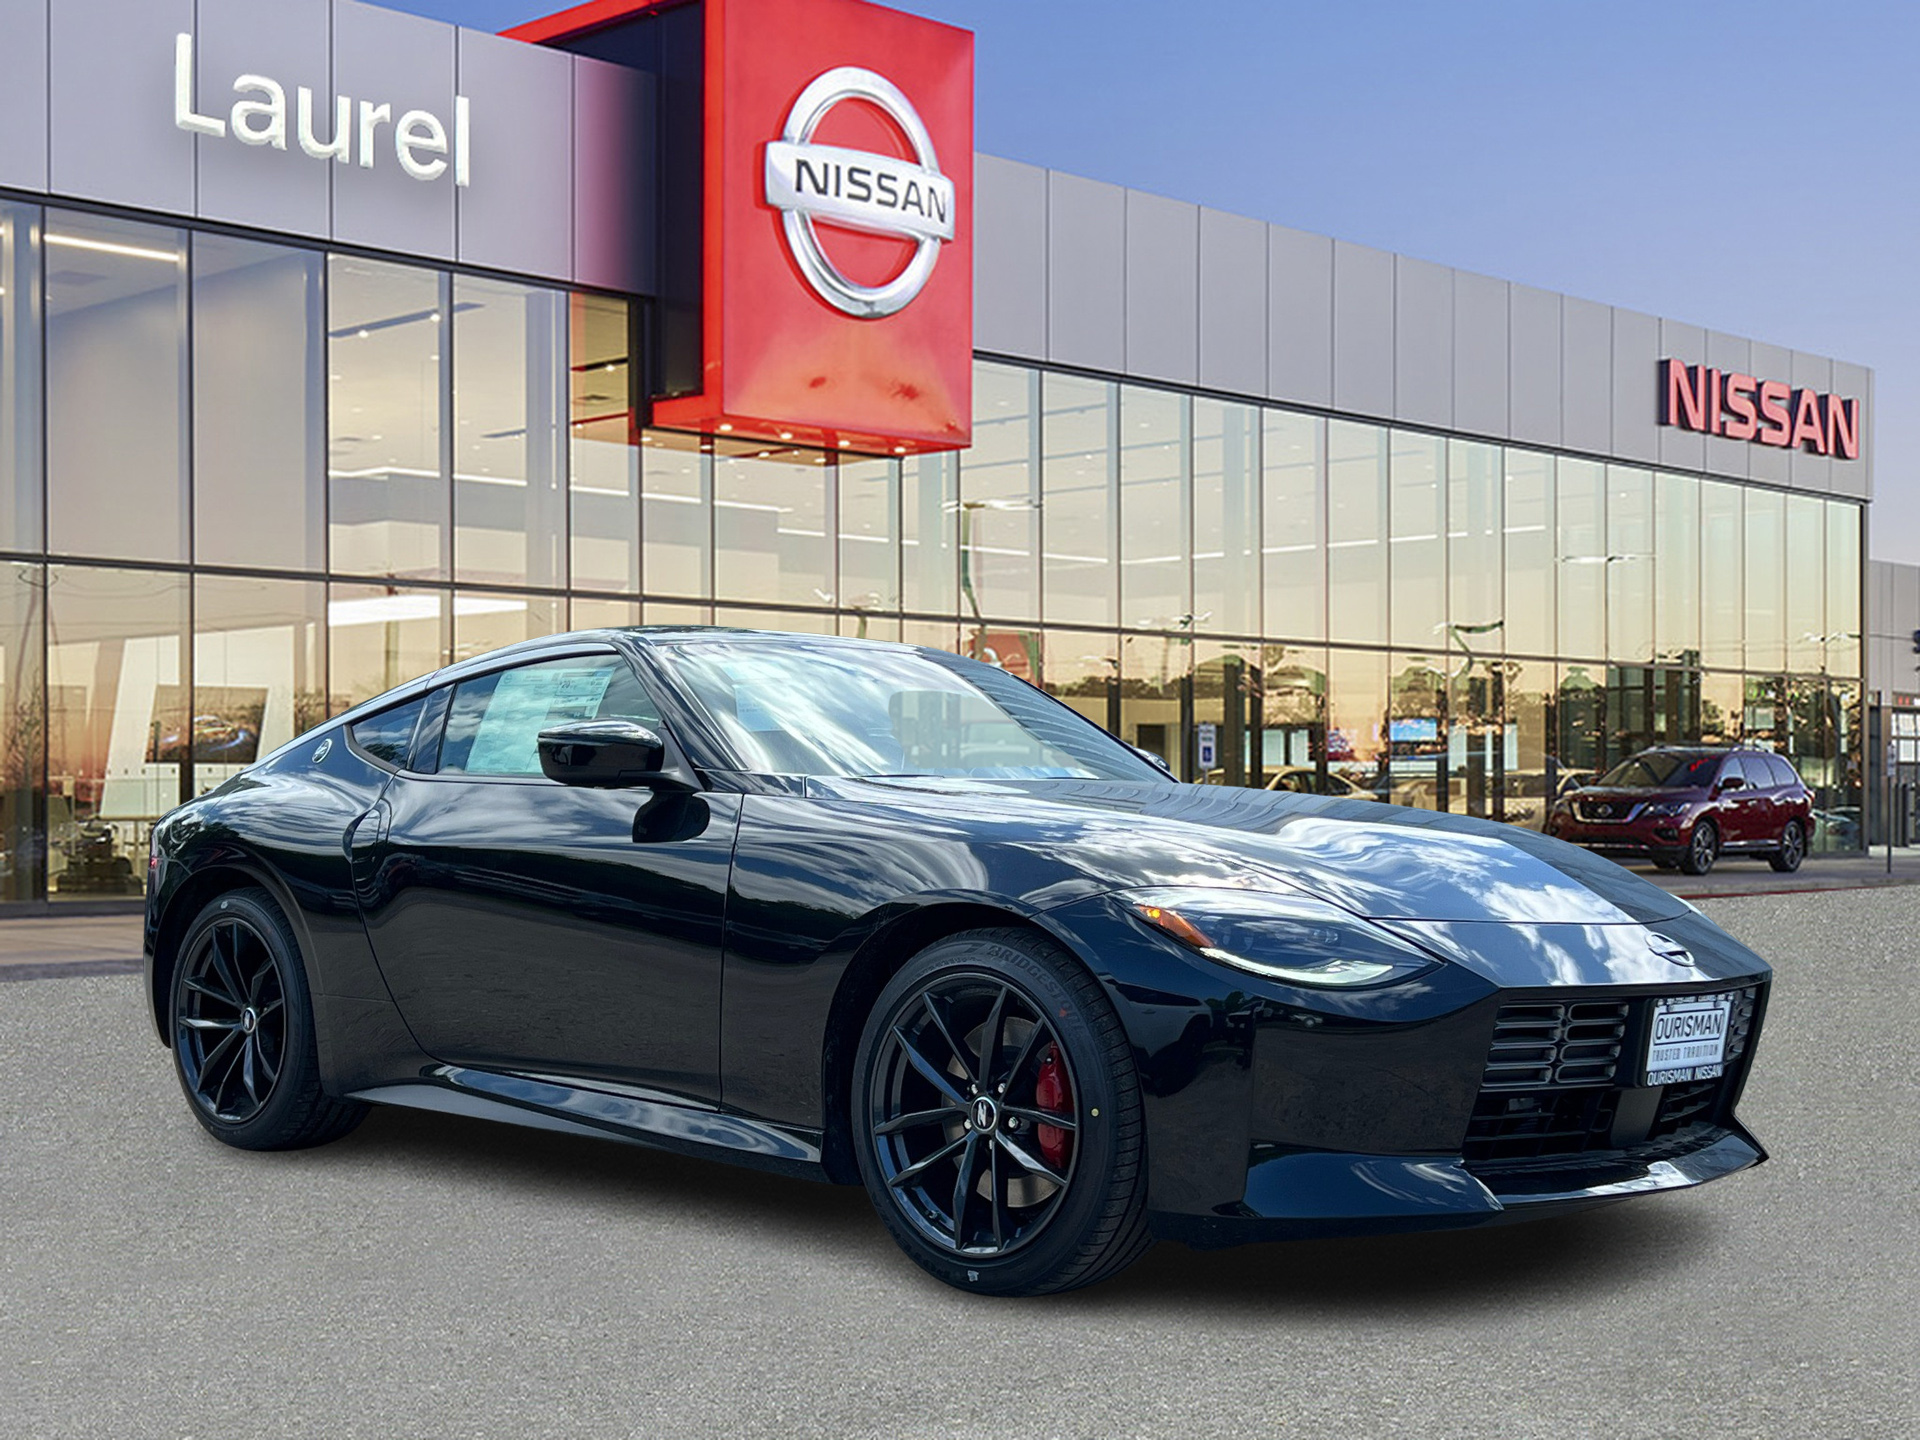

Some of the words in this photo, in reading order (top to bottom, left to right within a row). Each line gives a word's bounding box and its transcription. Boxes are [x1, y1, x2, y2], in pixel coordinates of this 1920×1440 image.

[175, 33, 470, 187] Laurel
[795, 159, 946, 223] NISSAN
[1659, 359, 1860, 459] NISSAN
[1655, 1013, 1724, 1040] OURISMAN
[1647, 1067, 1692, 1086] OURISMAN
[1694, 1063, 1723, 1081] NISSAN
[1652, 1047, 1681, 1062] TRUSTED
[1683, 1044, 1718, 1059] TRADITION
